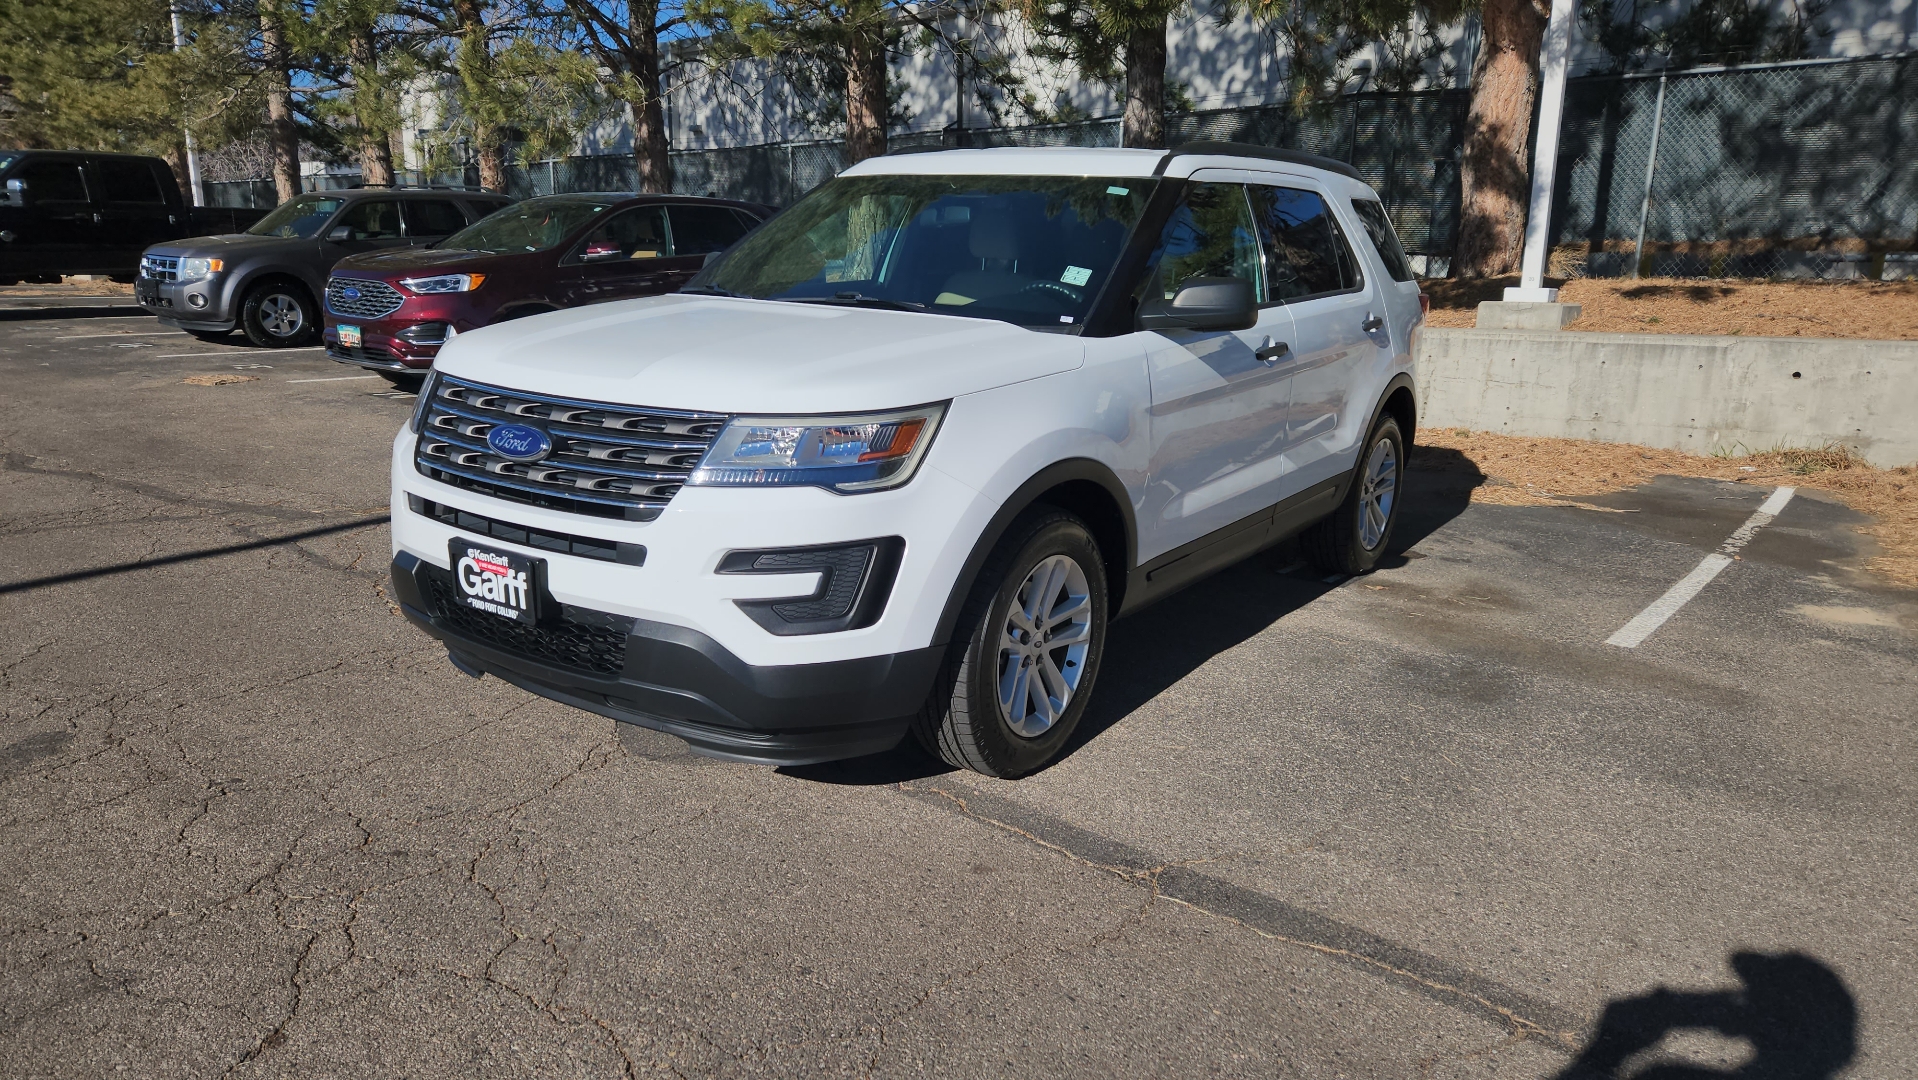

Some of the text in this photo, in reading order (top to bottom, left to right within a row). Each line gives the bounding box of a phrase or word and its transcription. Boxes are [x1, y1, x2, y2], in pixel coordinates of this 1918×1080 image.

[495, 428, 532, 452] Ford
[457, 556, 528, 610] Garff
[472, 598, 485, 610] FORD
[485, 602, 497, 613] FORT
